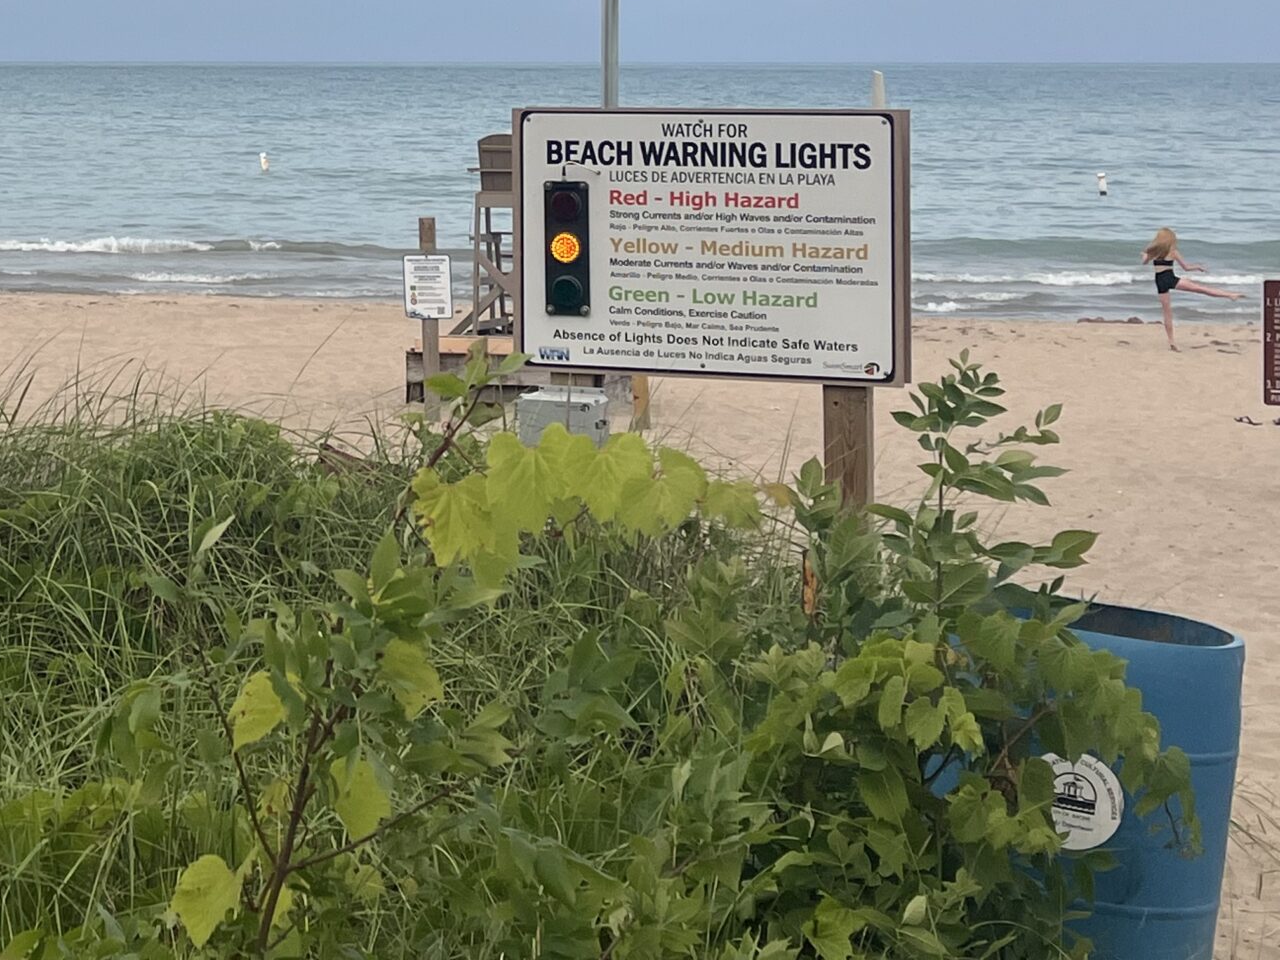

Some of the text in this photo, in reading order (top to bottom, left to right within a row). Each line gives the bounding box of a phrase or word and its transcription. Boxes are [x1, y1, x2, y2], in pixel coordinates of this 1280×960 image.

[662, 124, 748, 138] WATCH FOR
[546, 140, 872, 170] BEACH WARNING LIGHTS
[609, 171, 836, 186] LUCES DE ADVERTENCIA EN LA PLAYA
[609, 190, 648, 206] Red
[670, 191, 717, 210] High
[724, 192, 800, 209] Hazard
[609, 210, 876, 224] Strong Currents and/or High Waves and/or Contamination
[609, 238, 678, 254] Yellow
[700, 240, 784, 258] Medium
[792, 242, 868, 260] Hazard
[609, 258, 863, 274] Moderate Currents and/or Waves and/or Contamination
[647, 272, 673, 280] Peligro
[608, 286, 670, 302] Green
[692, 288, 736, 304] Low
[742, 290, 818, 308] Hazard
[609, 306, 766, 320] Calm Conditions, Exercise Caution
[553, 329, 858, 352] Absence of Lights Does Not Indicate Safe Waters
[584, 346, 812, 365] La Ausencia de Luces No Indica Aguas Seguras
